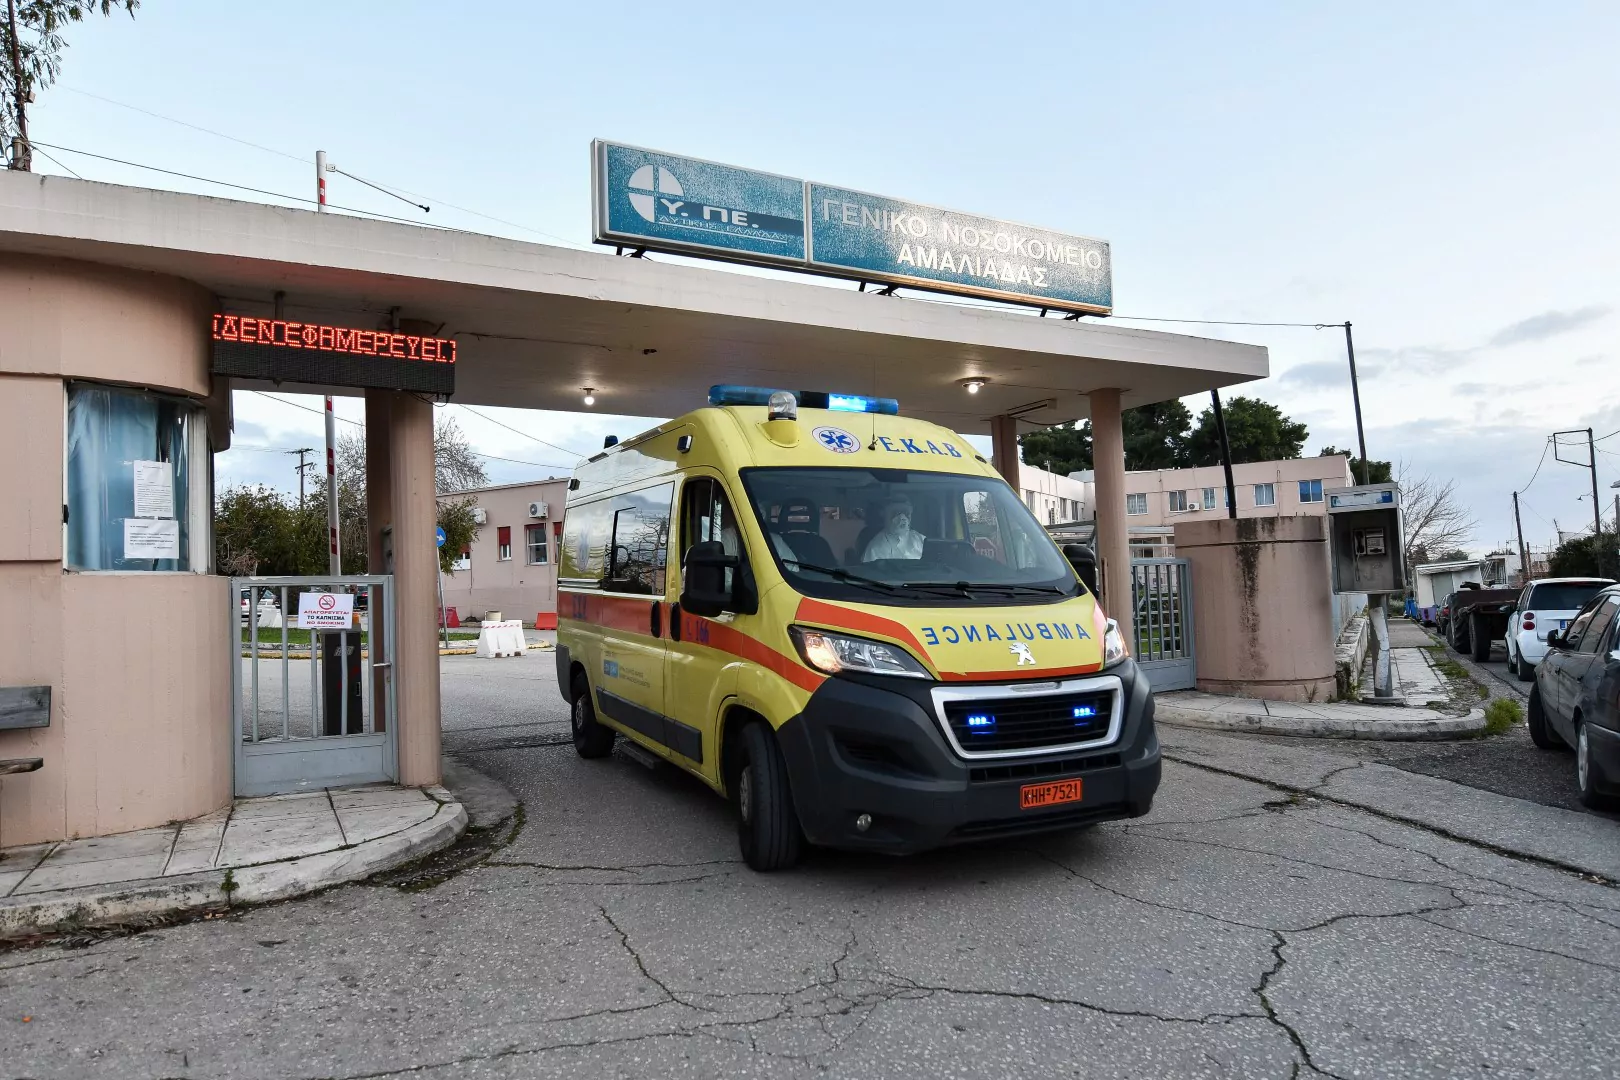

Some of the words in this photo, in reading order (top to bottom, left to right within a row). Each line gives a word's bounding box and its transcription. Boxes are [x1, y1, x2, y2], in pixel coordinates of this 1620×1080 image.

[822, 198, 928, 238] ΓΕΝΙΚΟ
[943, 221, 1102, 270] ΝΟΣΟΚΟΜΕΙΟ
[897, 243, 1049, 288] ΑΜΑΛΙΑΔΑΣ
